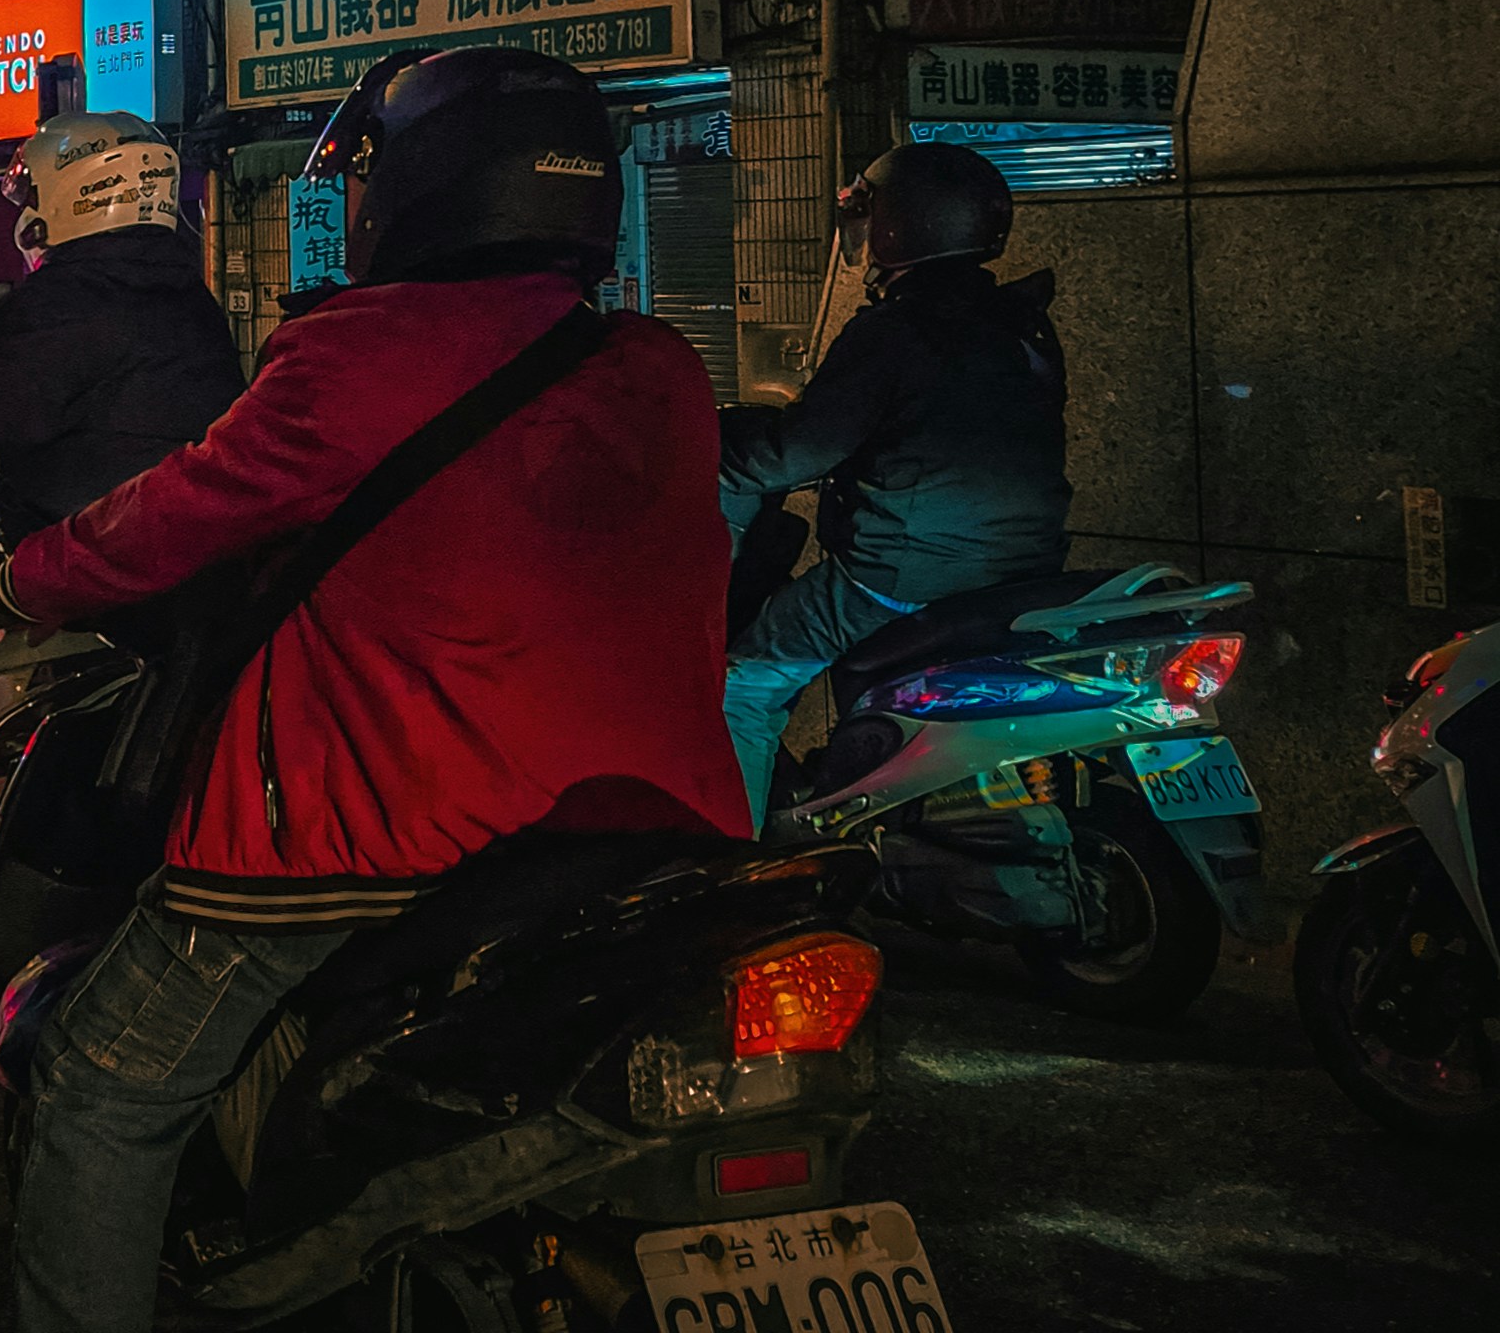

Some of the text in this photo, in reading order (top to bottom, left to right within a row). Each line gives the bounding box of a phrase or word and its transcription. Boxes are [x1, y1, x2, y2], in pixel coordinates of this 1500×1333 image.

[94, 20, 144, 48] 就是要玩
[96, 50, 146, 76] 台北門市
[232, 295, 246, 310] 33
[728, 1227, 834, 1270] 台北市
